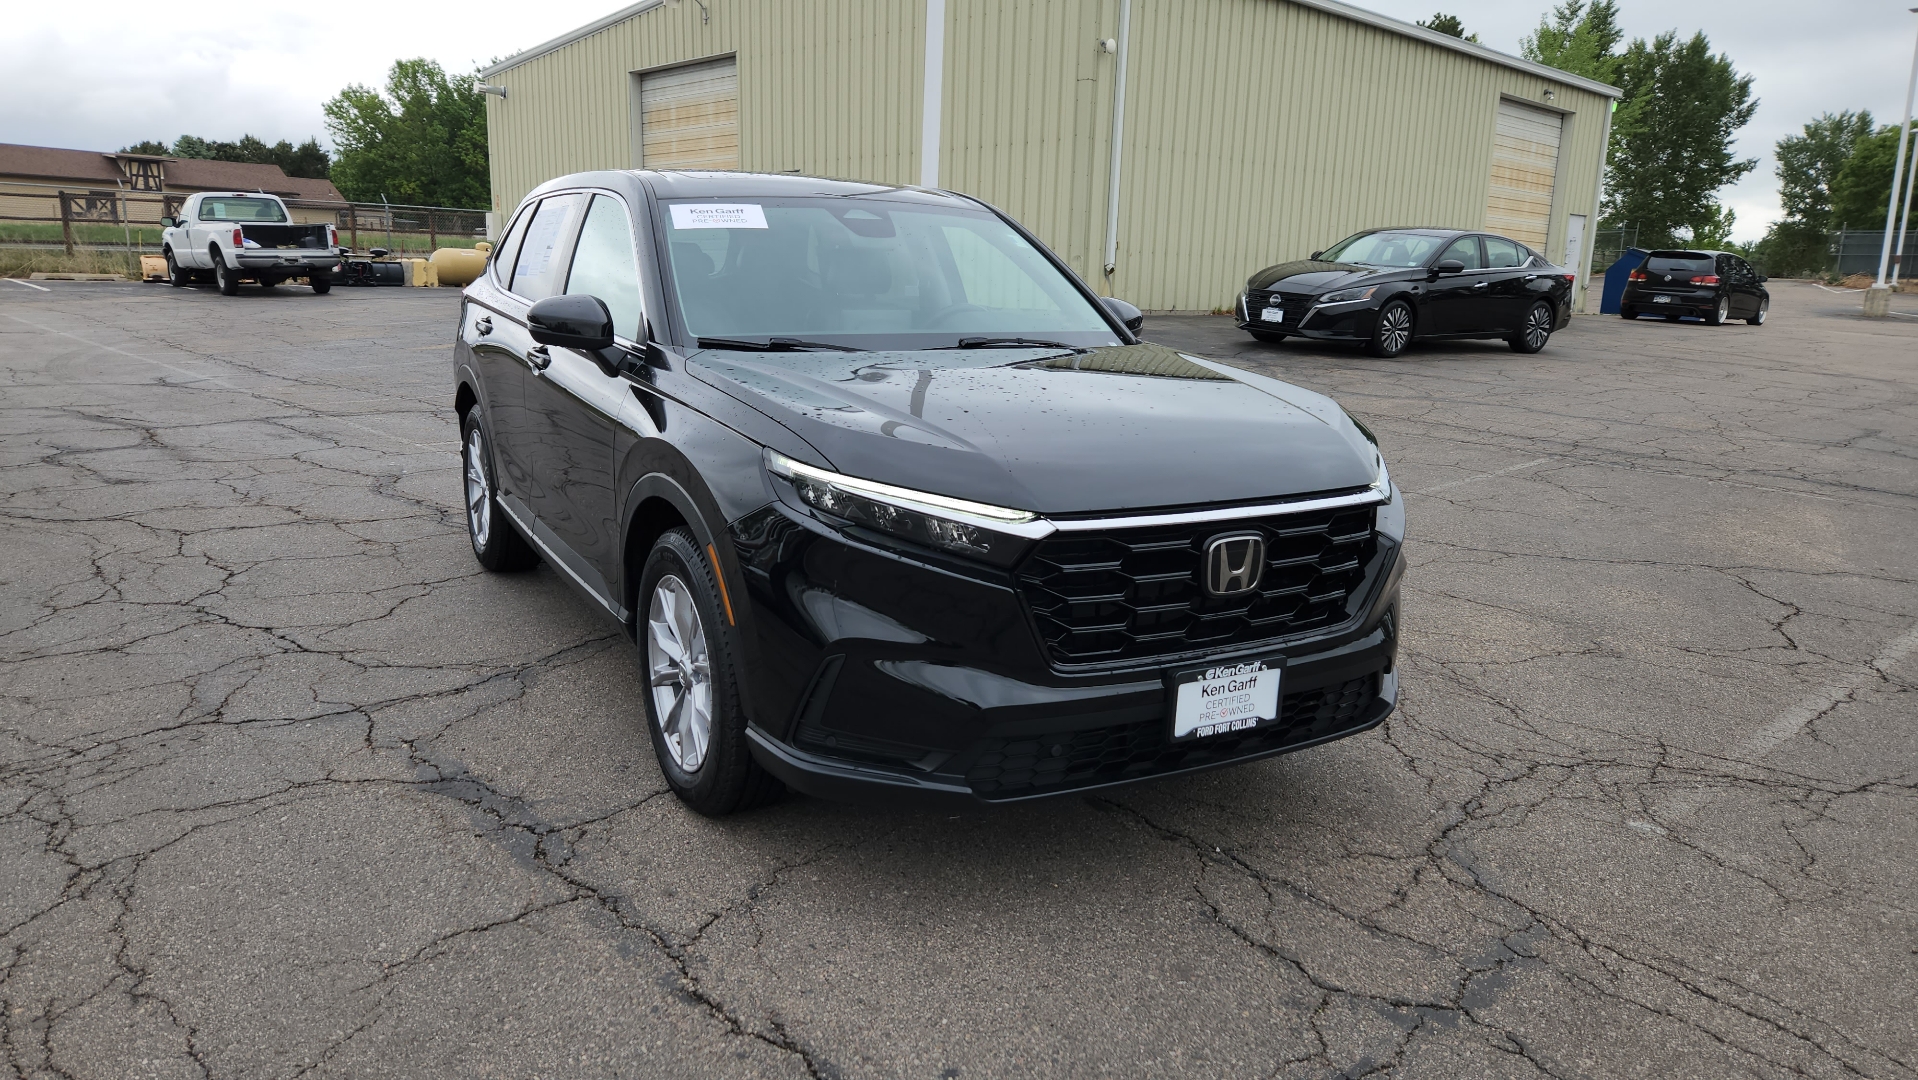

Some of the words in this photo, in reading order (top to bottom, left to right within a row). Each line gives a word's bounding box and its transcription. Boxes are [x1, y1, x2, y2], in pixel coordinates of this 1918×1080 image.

[1201, 683, 1225, 698] Ken
[1227, 676, 1258, 693] Garff
[1205, 693, 1251, 710] CERTIFIED
[1196, 725, 1214, 738] FORD
[1214, 722, 1231, 734] FORT
[1231, 718, 1258, 731] COLLINS
